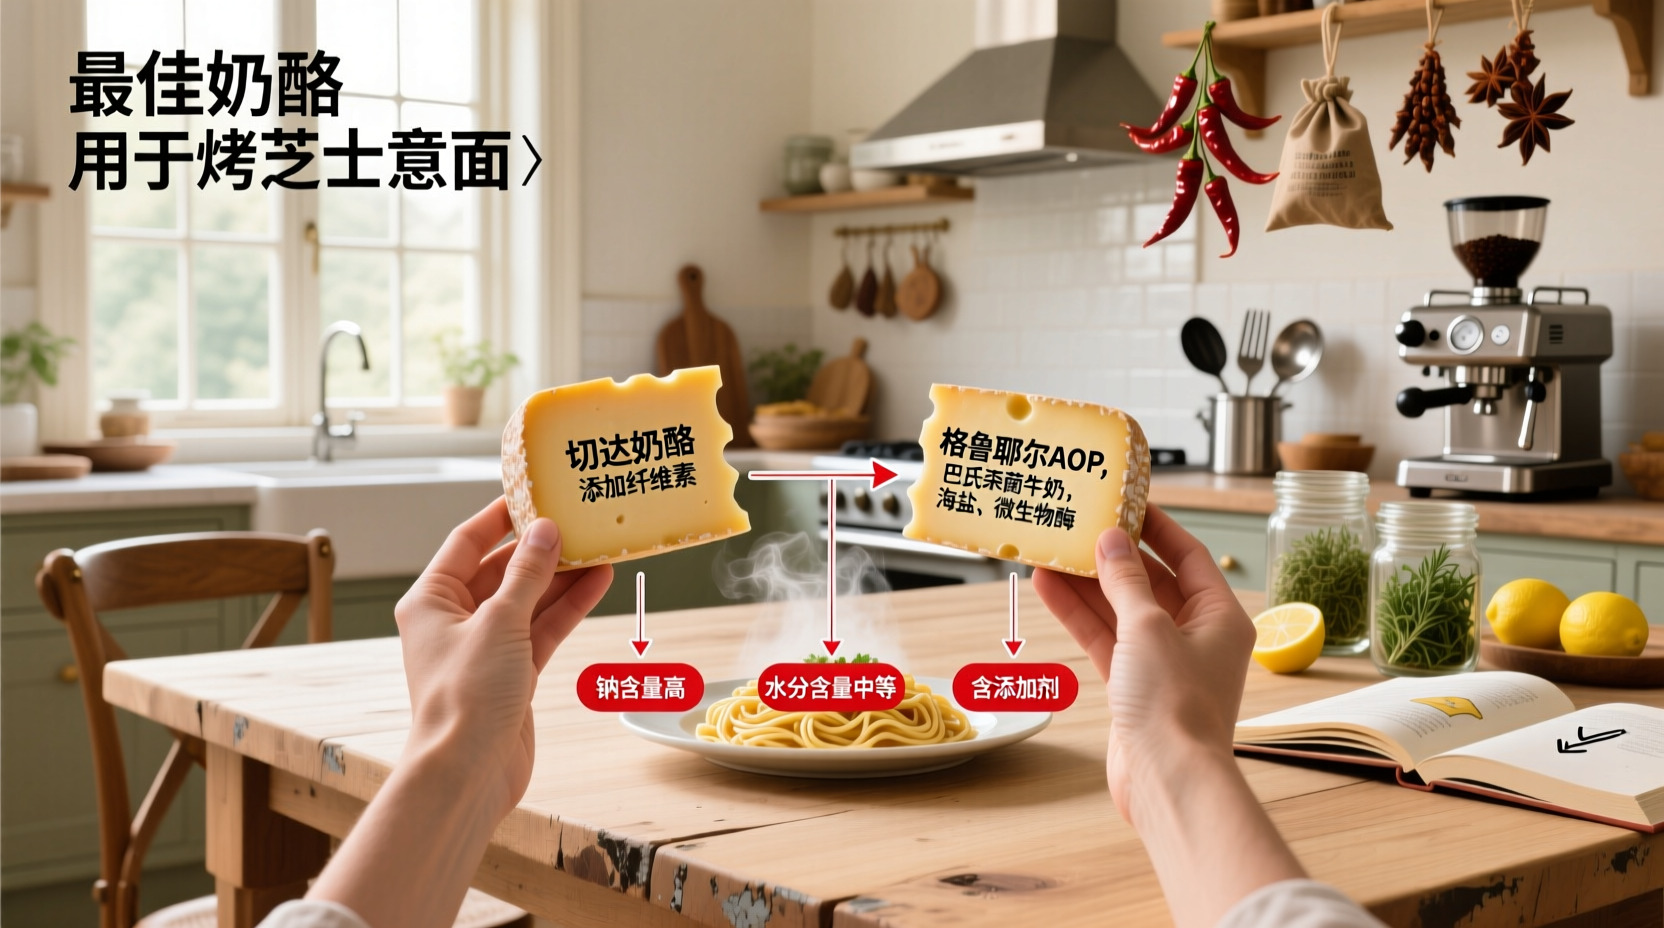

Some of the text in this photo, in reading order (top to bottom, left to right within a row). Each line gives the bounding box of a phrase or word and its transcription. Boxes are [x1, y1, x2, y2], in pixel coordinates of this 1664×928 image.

[565, 424, 695, 472] 切达奶酪
[579, 462, 697, 503] 添加纤维素
